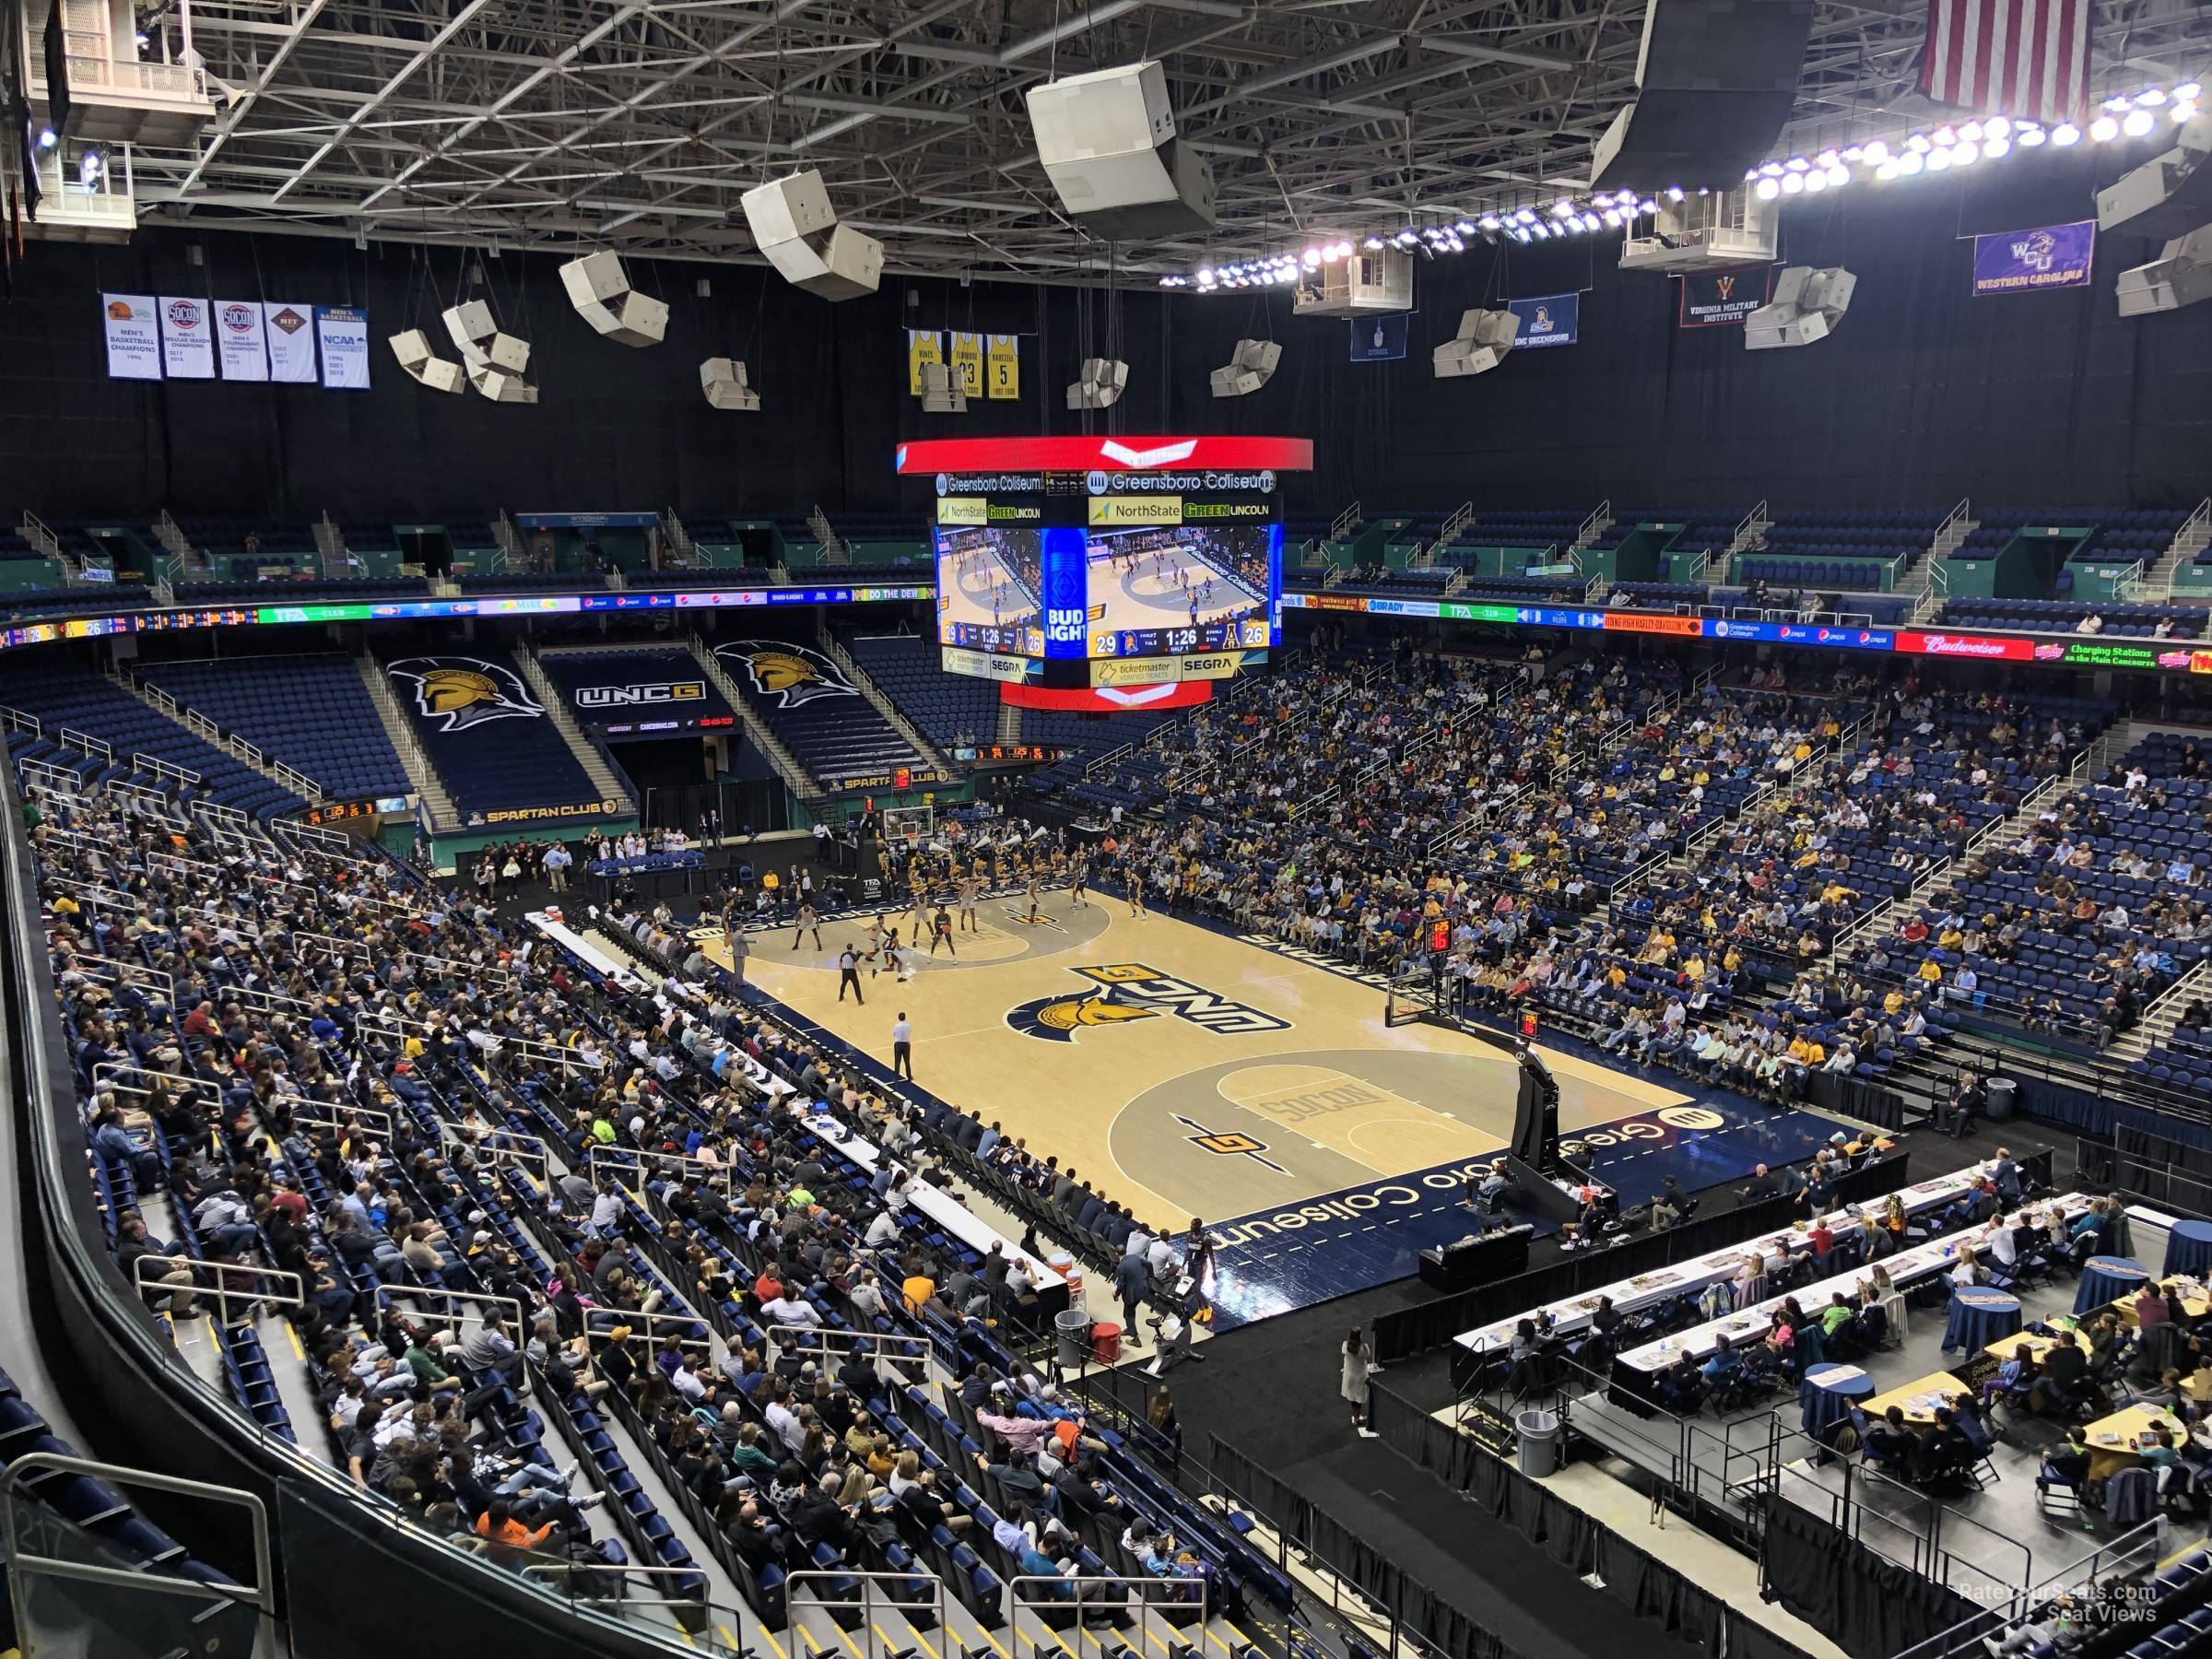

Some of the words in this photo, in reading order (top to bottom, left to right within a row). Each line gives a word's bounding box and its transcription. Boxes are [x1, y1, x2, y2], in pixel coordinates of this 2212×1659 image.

[1978, 276, 2028, 289] WESTERN
[2030, 269, 2083, 284] CAROLINA
[1690, 305, 1721, 314] VIRGINIA
[1724, 300, 1759, 312] MILITARY
[321, 313, 363, 322] BASKETBALL
[1704, 312, 1743, 323] INSTITUTE
[111, 336, 155, 345] BASKETBALL
[324, 335, 355, 345] NCAA
[111, 345, 156, 353] CHAMPIONS
[999, 365, 1007, 385] 5
[948, 476, 997, 492] Greensboro
[999, 475, 1041, 490] Coliseum
[1112, 474, 1201, 490] Greensboro
[1206, 470, 1270, 489] Coliseum
[951, 507, 986, 518] NorthState
[1116, 504, 1180, 517] NorthState
[869, 590, 882, 599] DO
[883, 590, 899, 598] THE
[900, 589, 918, 598] DEW
[1377, 601, 1405, 612] BRADY
[1450, 605, 1473, 619] TFA
[273, 608, 310, 622] TFA
[1048, 609, 1084, 625] BUD
[88, 622, 101, 636] 26
[1605, 617, 1622, 628] RIDING
[1622, 618, 1635, 629] HIGH
[1729, 624, 1760, 632] Greensboro
[945, 625, 956, 641] 29
[981, 628, 1000, 644] 1:26
[1166, 629, 1197, 646] 1:26
[1245, 627, 1264, 644] 26
[1729, 629, 1754, 638] Coliseum
[1791, 629, 1806, 639] pepsi
[1830, 632, 1846, 641] pepsi
[1028, 635, 1041, 653] 26
[1096, 635, 1116, 653] 29
[1870, 636, 1888, 644] pepsi
[1923, 634, 2006, 655] Budweiser
[2071, 644, 2111, 657] Charging
[2112, 646, 2152, 658] Stations
[992, 660, 1021, 673] SEGRA
[1183, 659, 1232, 671] SEGRA
[2077, 654, 2089, 663] the
[2090, 655, 2111, 665] Main
[2112, 657, 2157, 667] Concourse
[1120, 663, 1171, 674] ticketmaster
[580, 683, 701, 706] UNCG
[912, 772, 935, 782] LUB
[487, 806, 559, 823] SPARTAN
[560, 803, 601, 817] CLUB
[863, 878, 881, 887] TFA
[1434, 920, 1449, 933] 1:25
[1432, 931, 1448, 949] 16
[1259, 1082, 1387, 1124] SOCON
